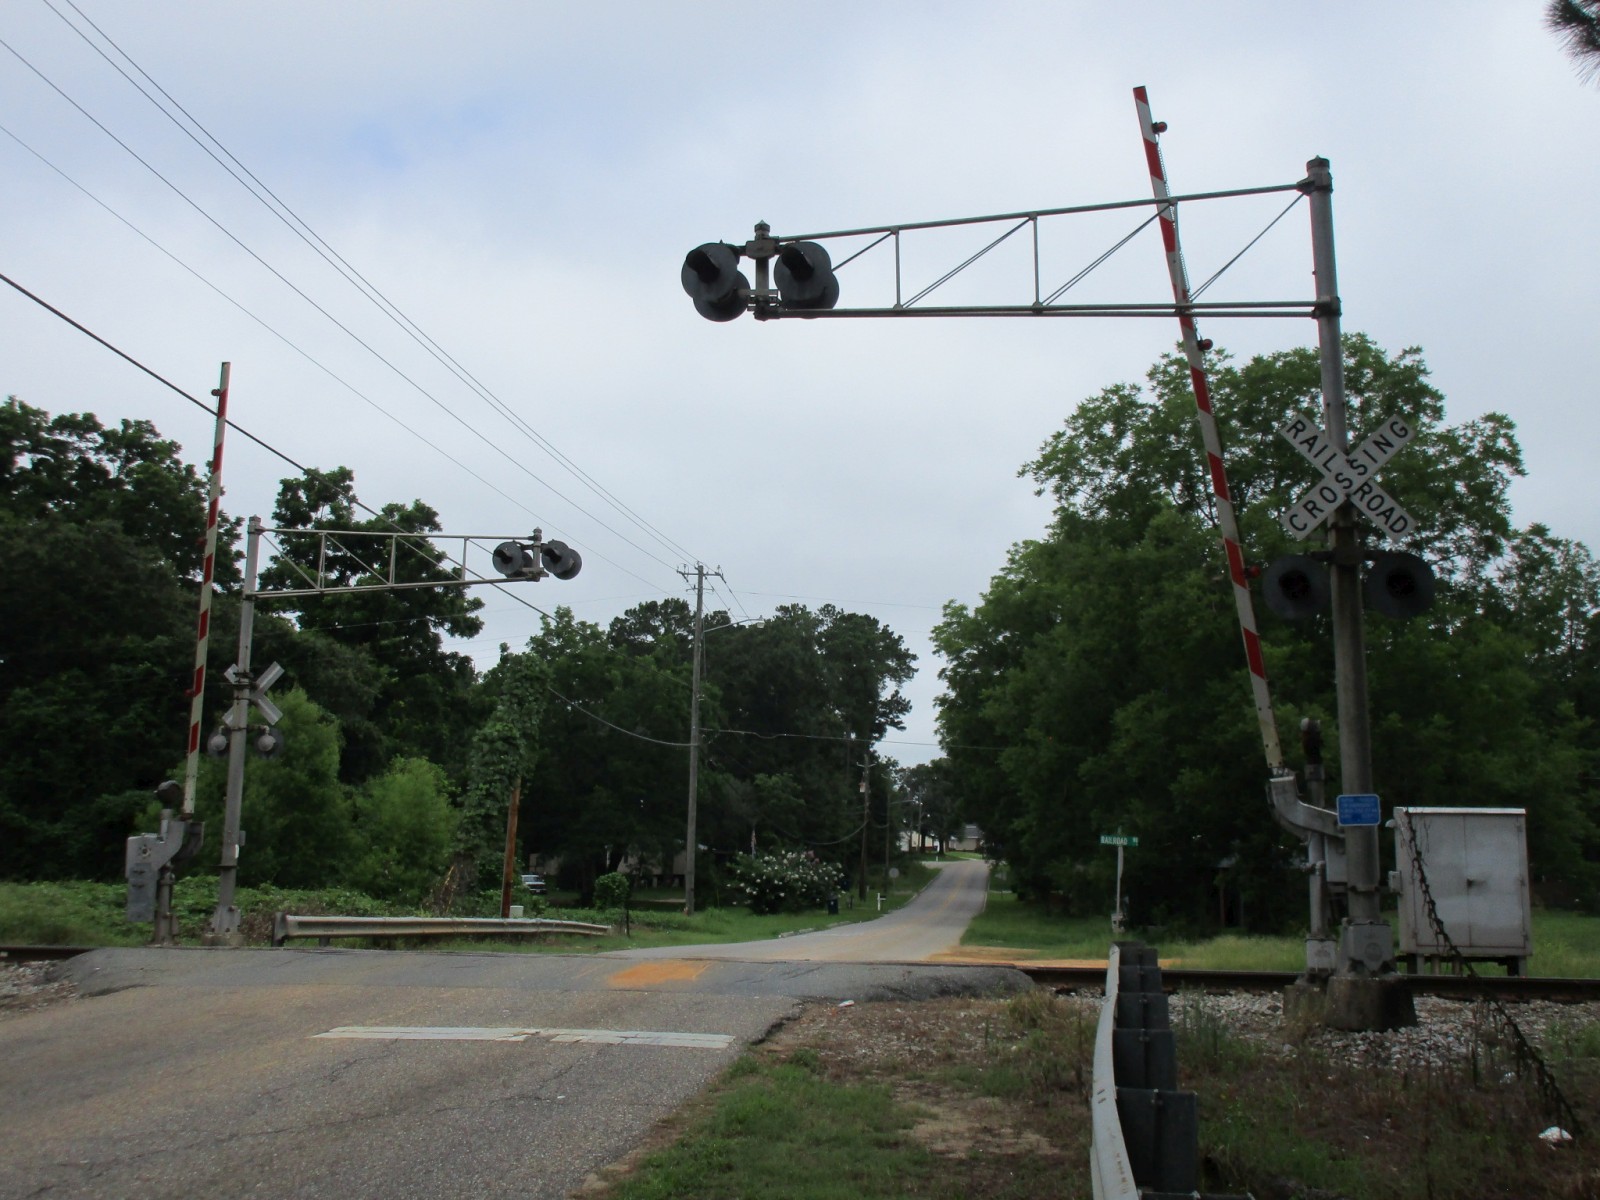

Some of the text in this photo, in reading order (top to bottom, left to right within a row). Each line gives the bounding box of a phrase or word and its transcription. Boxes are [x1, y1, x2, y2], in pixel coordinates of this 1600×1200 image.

[1286, 419, 1408, 534] RAIL ROAD
[1289, 421, 1408, 532] CROSSING
[1100, 835, 1128, 846] RAILROAD
